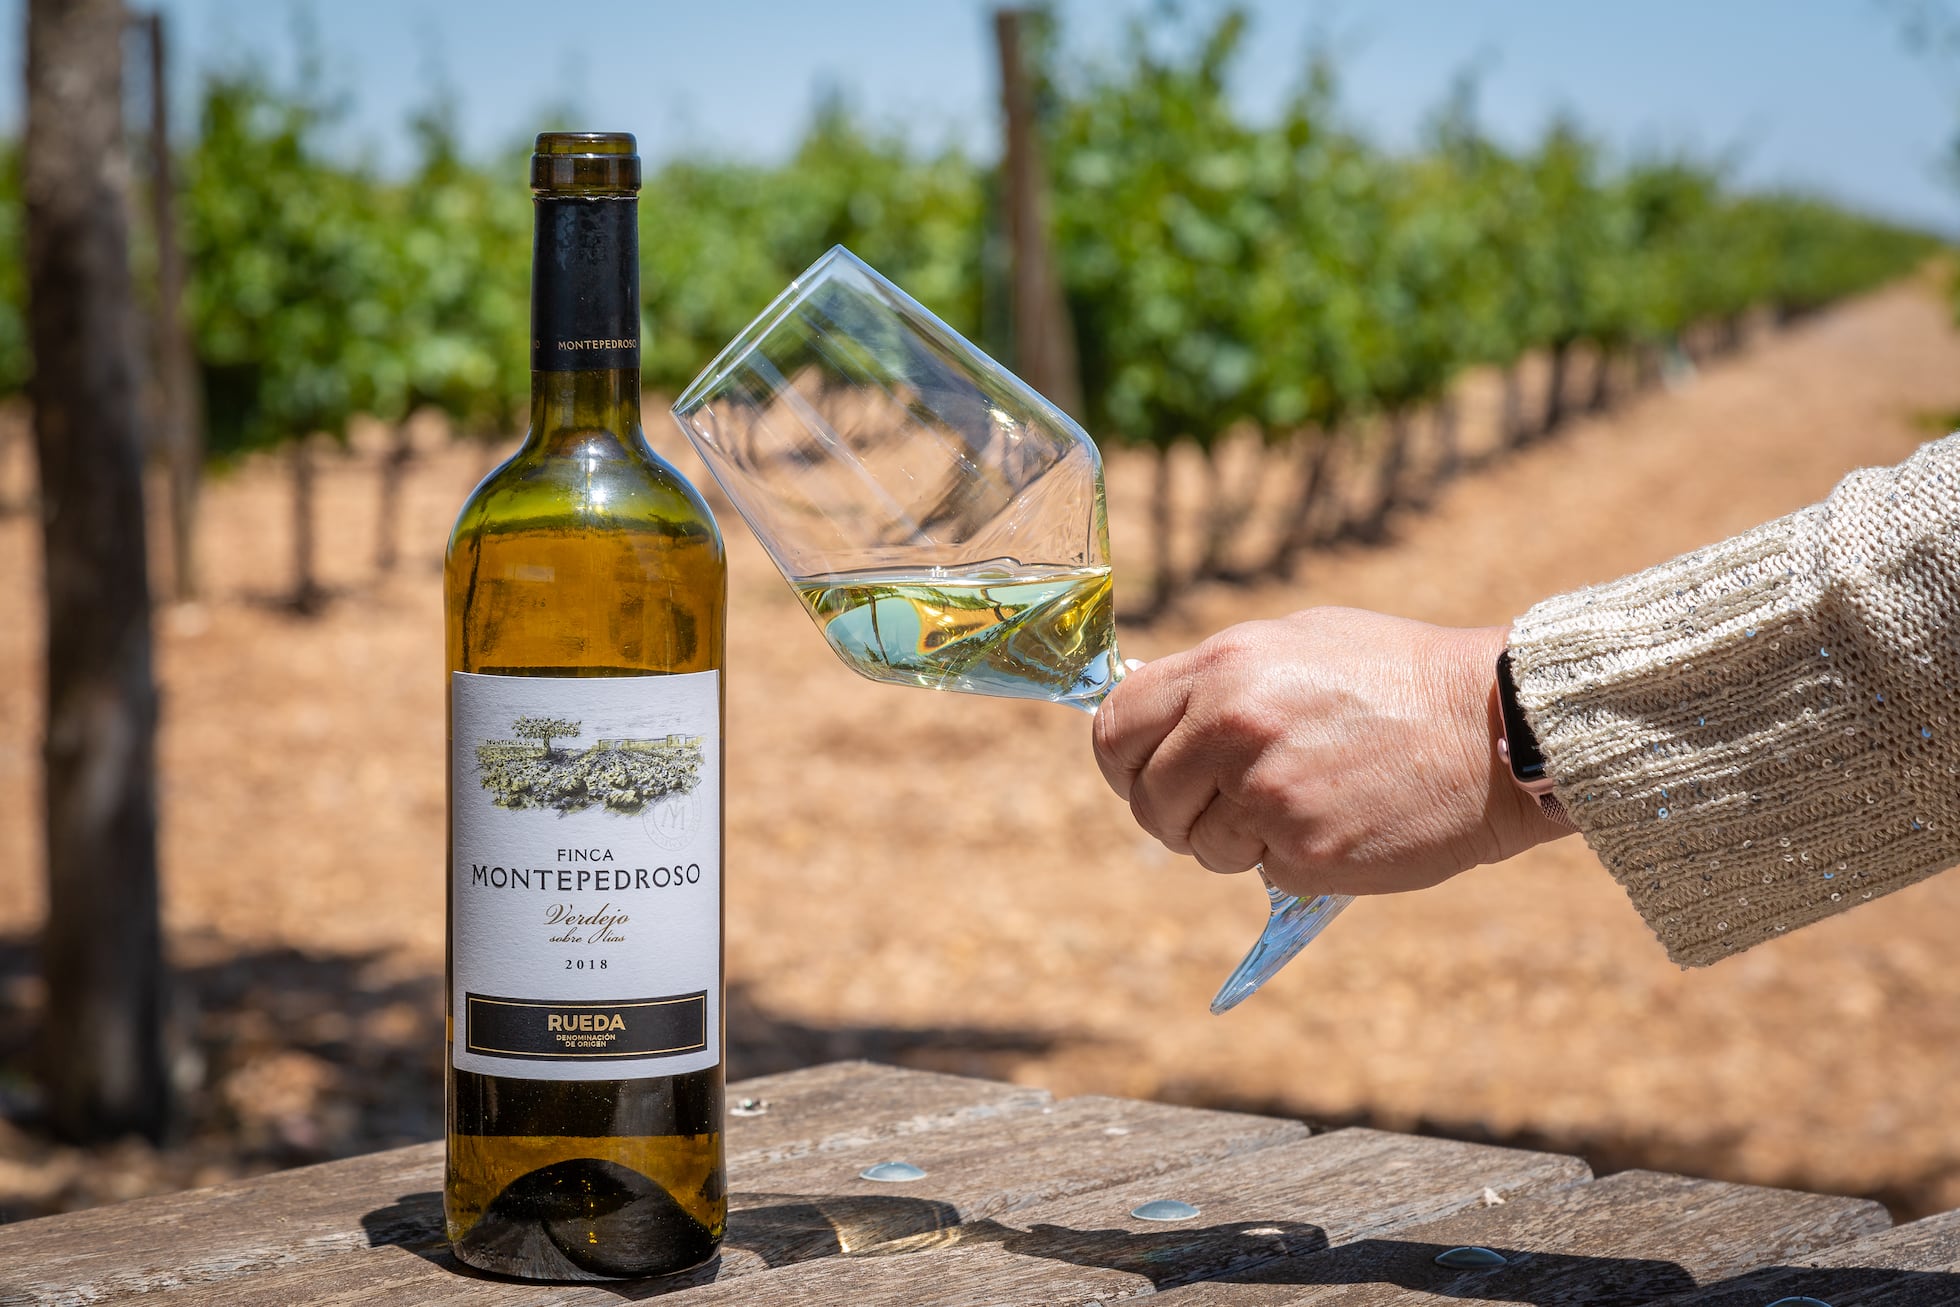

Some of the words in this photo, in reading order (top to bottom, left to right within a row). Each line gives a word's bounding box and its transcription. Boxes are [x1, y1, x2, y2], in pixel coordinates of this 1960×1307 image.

[558, 339, 637, 350] MONTEPEDROSO
[557, 848, 614, 862] FINCA
[472, 863, 701, 891] MONTEPEDROSO
[543, 902, 630, 944] Verdejo
[549, 926, 582, 943] sobre
[565, 959, 608, 970] 2018
[548, 1013, 626, 1032] RUEDA
[556, 1033, 616, 1041] DENOMINACIÓN
